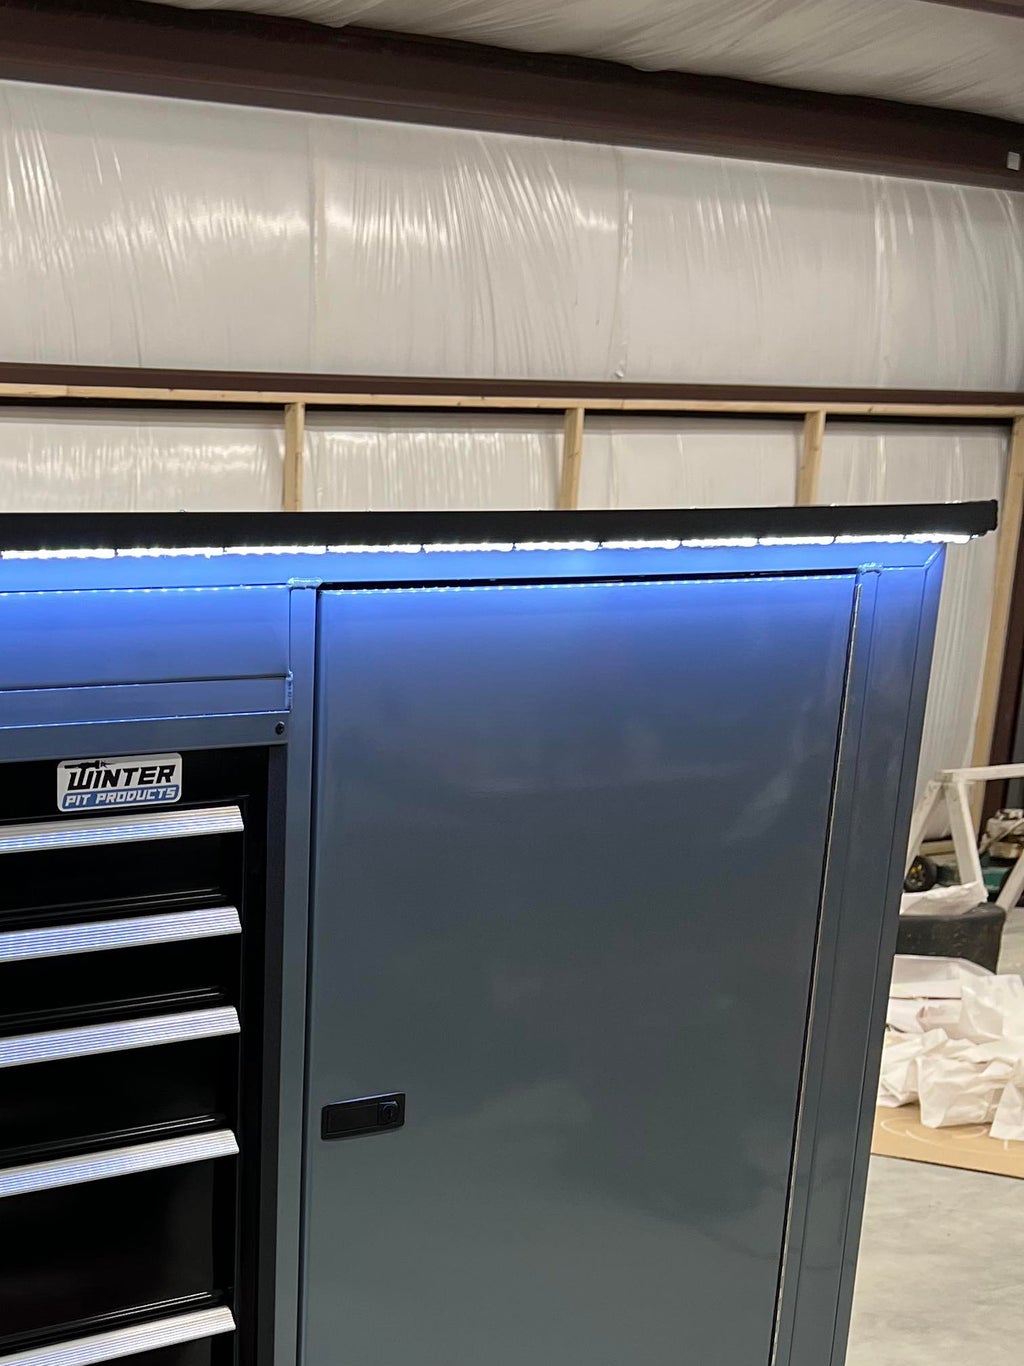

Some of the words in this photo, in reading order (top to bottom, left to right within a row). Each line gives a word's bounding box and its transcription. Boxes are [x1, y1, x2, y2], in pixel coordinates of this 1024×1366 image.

[64, 761, 176, 791] WINTER
[65, 795, 91, 807] PIT
[95, 787, 177, 805] PRODUCTS
